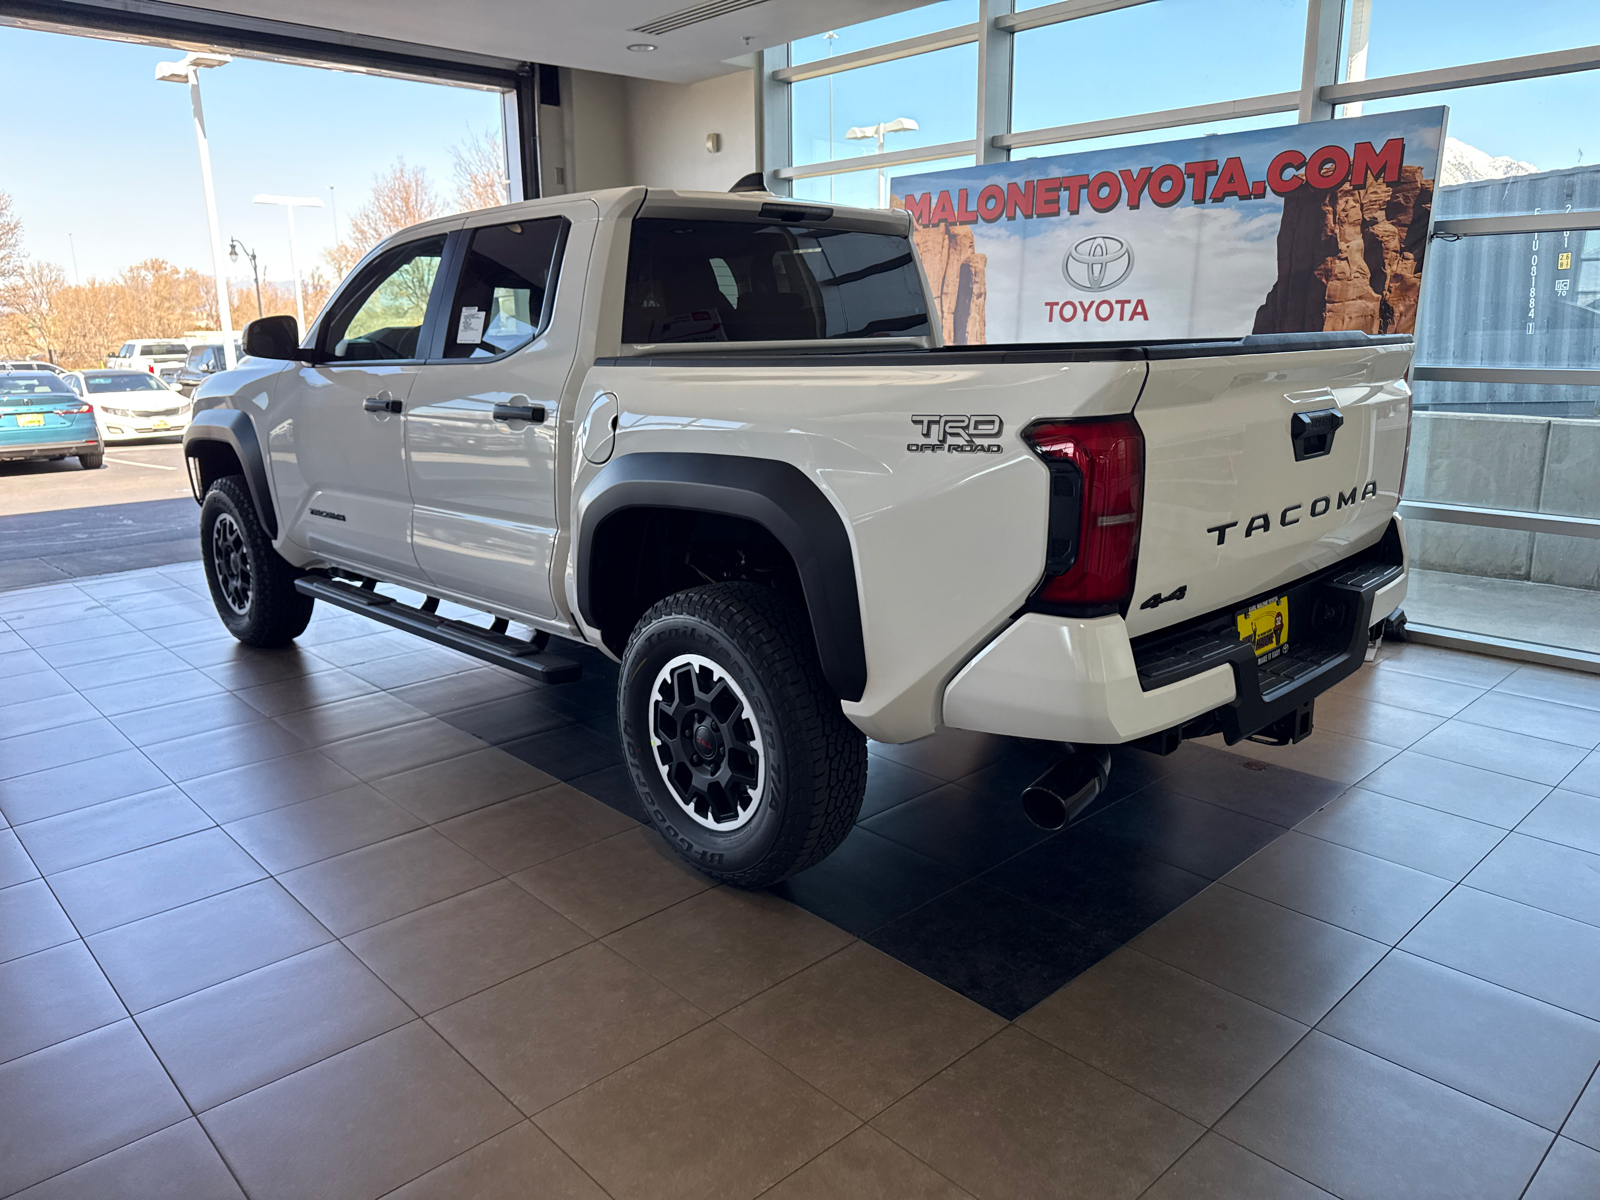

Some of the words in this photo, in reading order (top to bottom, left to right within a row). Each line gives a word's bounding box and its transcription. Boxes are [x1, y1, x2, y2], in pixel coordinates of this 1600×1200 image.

[904, 137, 1405, 227] MALONETOYOTA.COM
[1044, 299, 1149, 323] TOYOTA
[911, 414, 1004, 444] TRD
[907, 443, 945, 453] OFF
[947, 443, 1004, 454] ROAD
[1206, 480, 1377, 546] TACOMA
